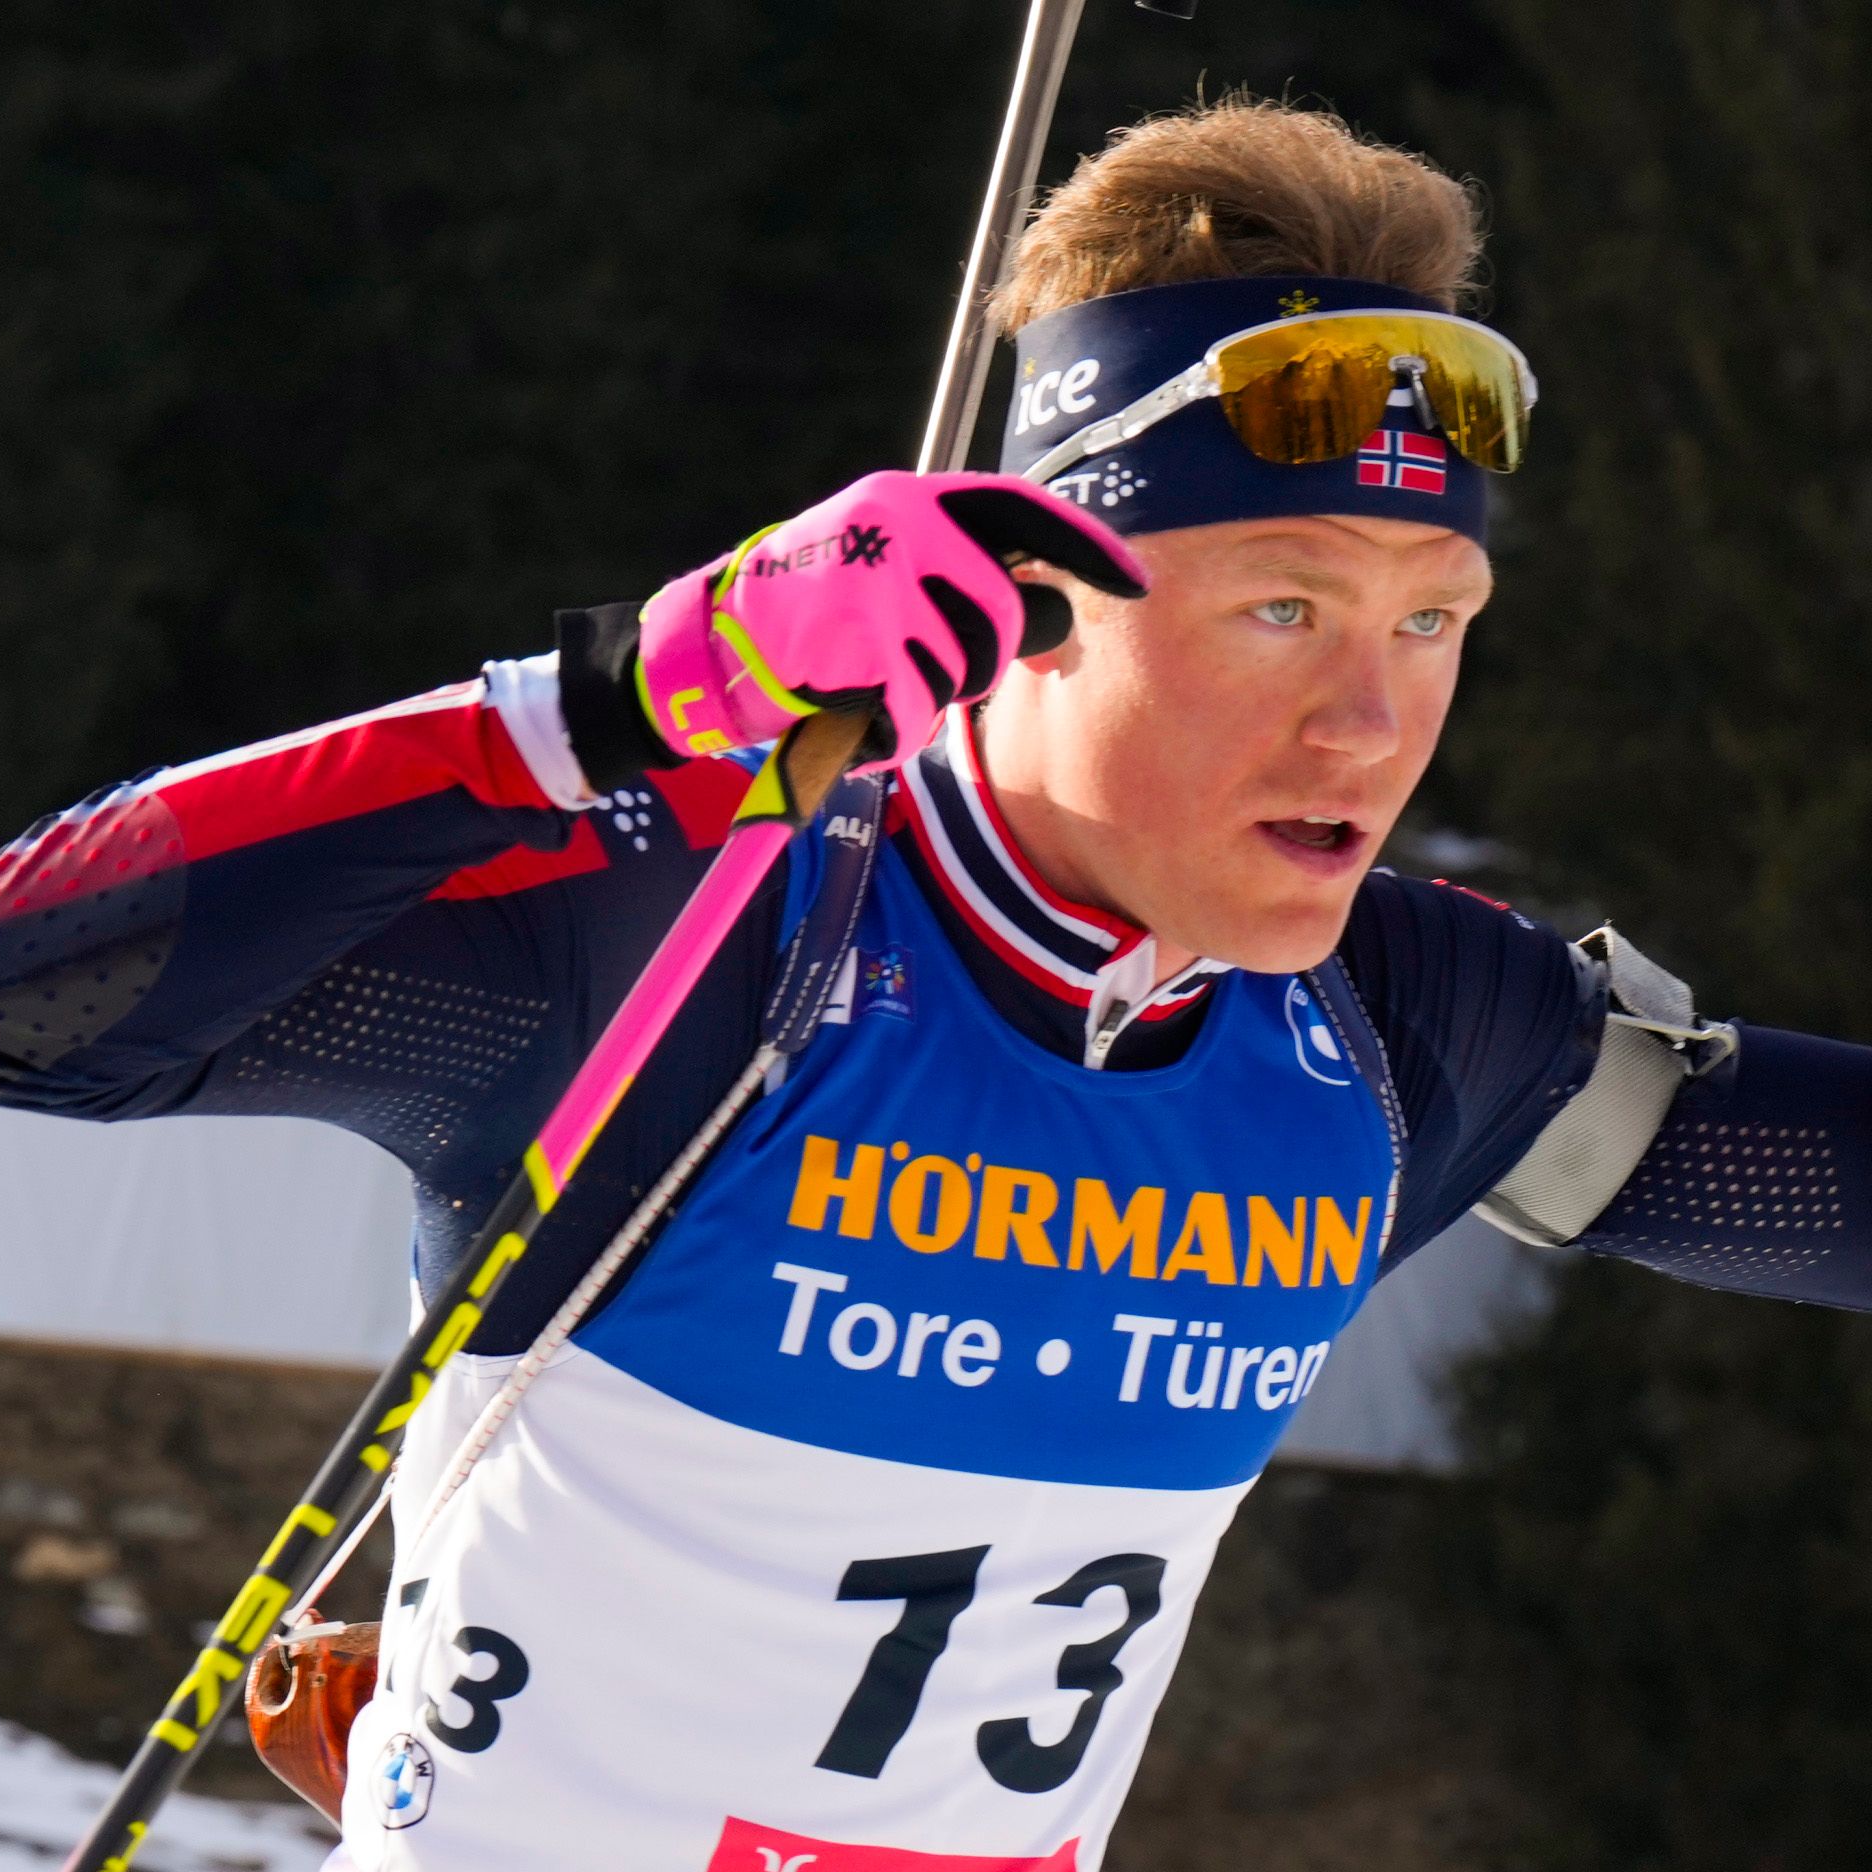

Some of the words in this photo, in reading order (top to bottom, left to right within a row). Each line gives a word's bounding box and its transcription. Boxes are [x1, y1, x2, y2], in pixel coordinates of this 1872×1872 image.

[786, 1134, 1373, 1288] HÖRMANN
[771, 1262, 1001, 1387] Tore
[1113, 1313, 1330, 1412] Türen
[149, 1504, 337, 1751] LEKI
[814, 1543, 1168, 1794] 13
